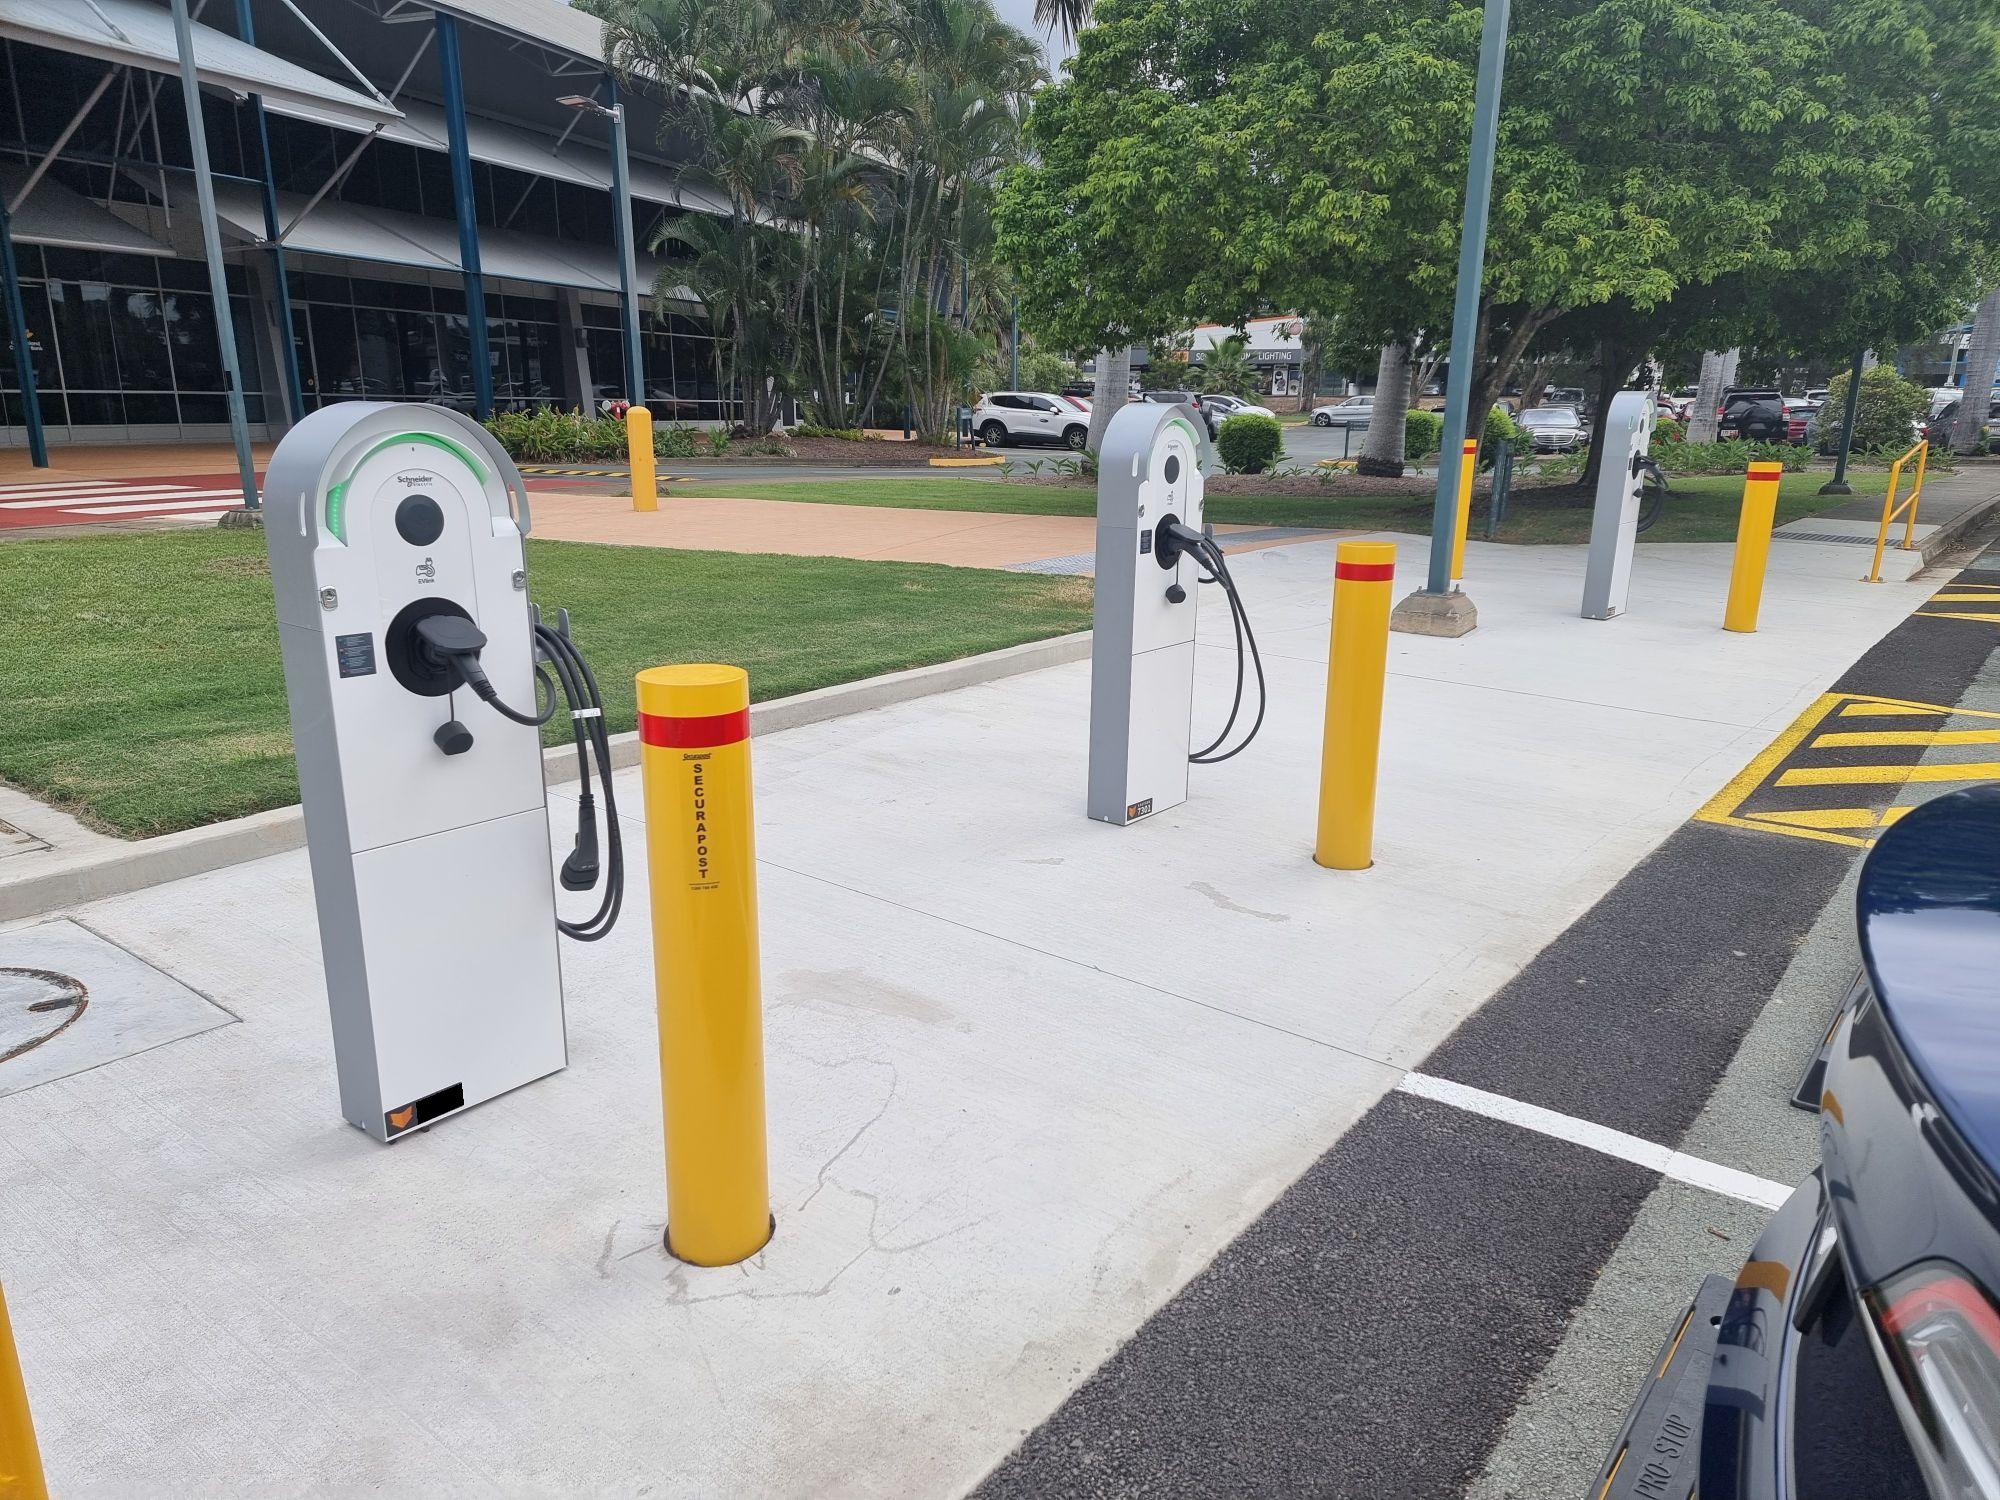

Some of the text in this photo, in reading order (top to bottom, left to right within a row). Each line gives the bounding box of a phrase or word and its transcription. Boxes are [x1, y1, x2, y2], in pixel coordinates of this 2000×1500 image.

[1258, 351, 1292, 360] LIGHTING
[397, 475, 433, 484] Schneider
[693, 763, 709, 879] SECURAPOST
[1633, 1414, 1692, 1500] PRO-STOP
